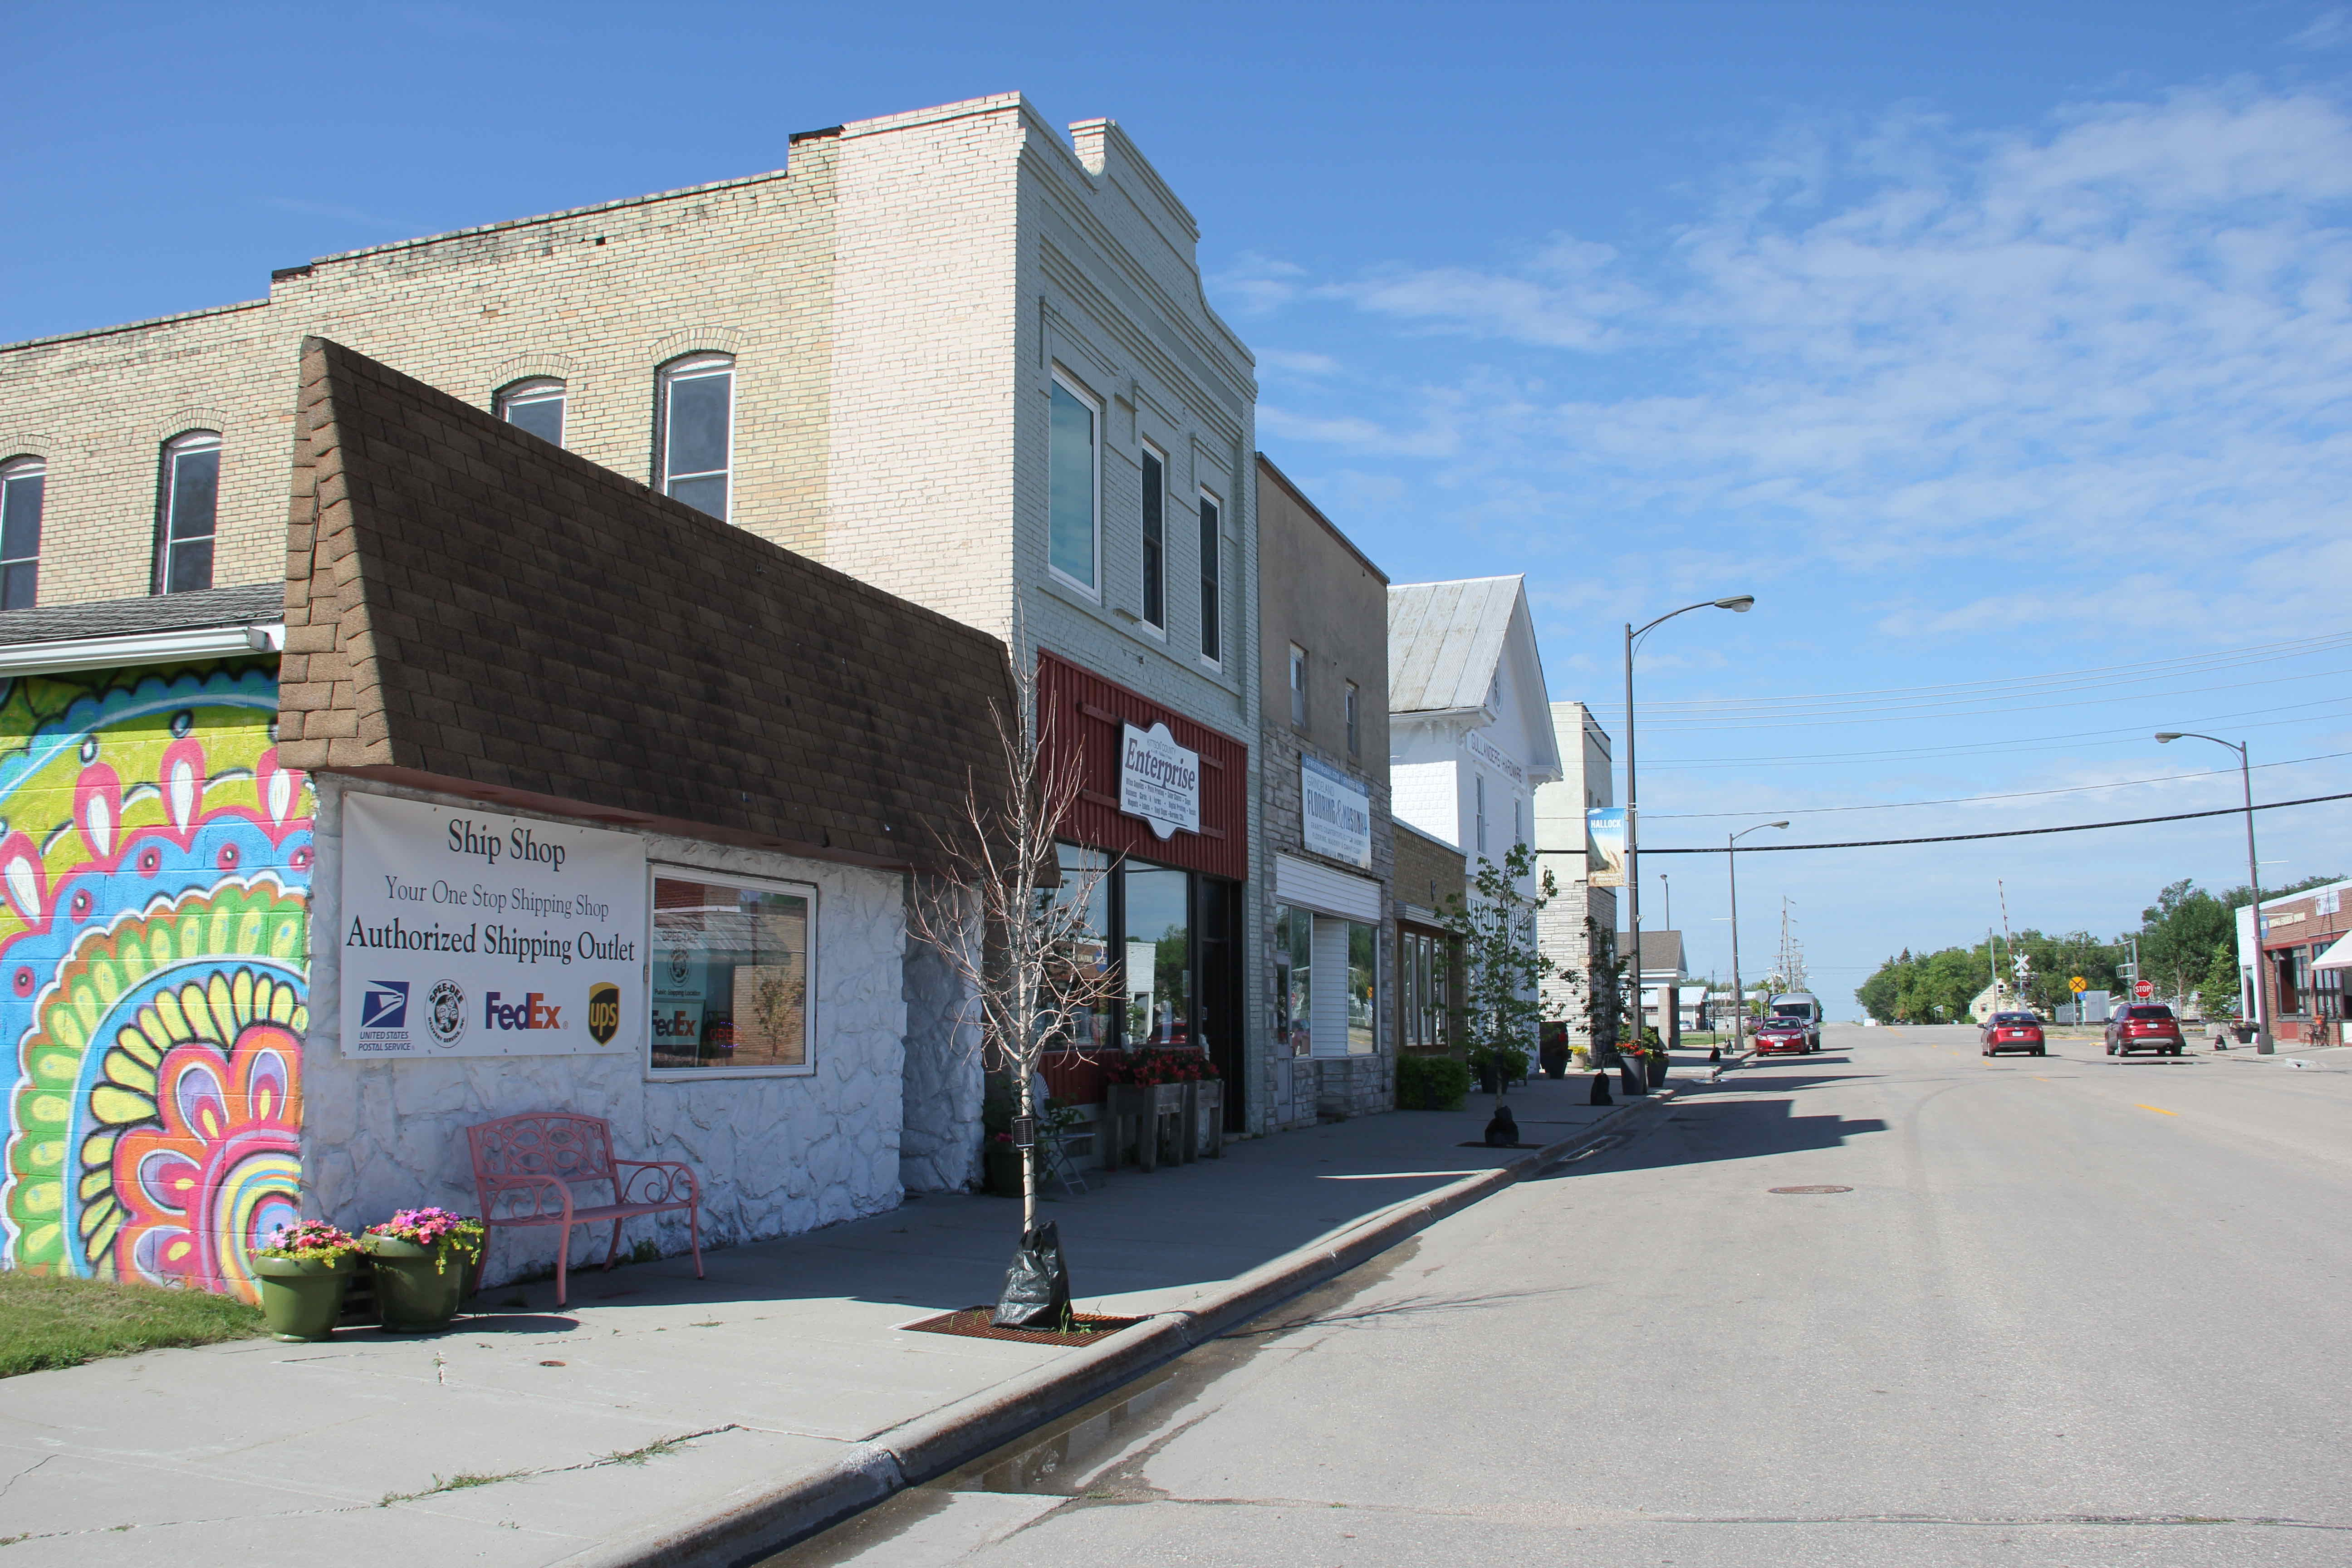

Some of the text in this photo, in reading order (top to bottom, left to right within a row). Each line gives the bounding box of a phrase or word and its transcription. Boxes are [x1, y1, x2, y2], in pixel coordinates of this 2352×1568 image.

[1125, 738, 1195, 791] Enterprise
[1307, 789, 1367, 838] FLOORING & MASONRY
[1591, 819, 1621, 828] HALLOCK
[449, 818, 565, 872] Ship Shop
[385, 875, 609, 922] Your One Stop Shipping Shop
[346, 914, 635, 965] Authorized Shipping Outlet
[429, 983, 464, 1004] SPEE-DEE
[486, 992, 562, 1030] FedEx
[591, 1003, 617, 1036] ups
[652, 1010, 696, 1037] FedEx
